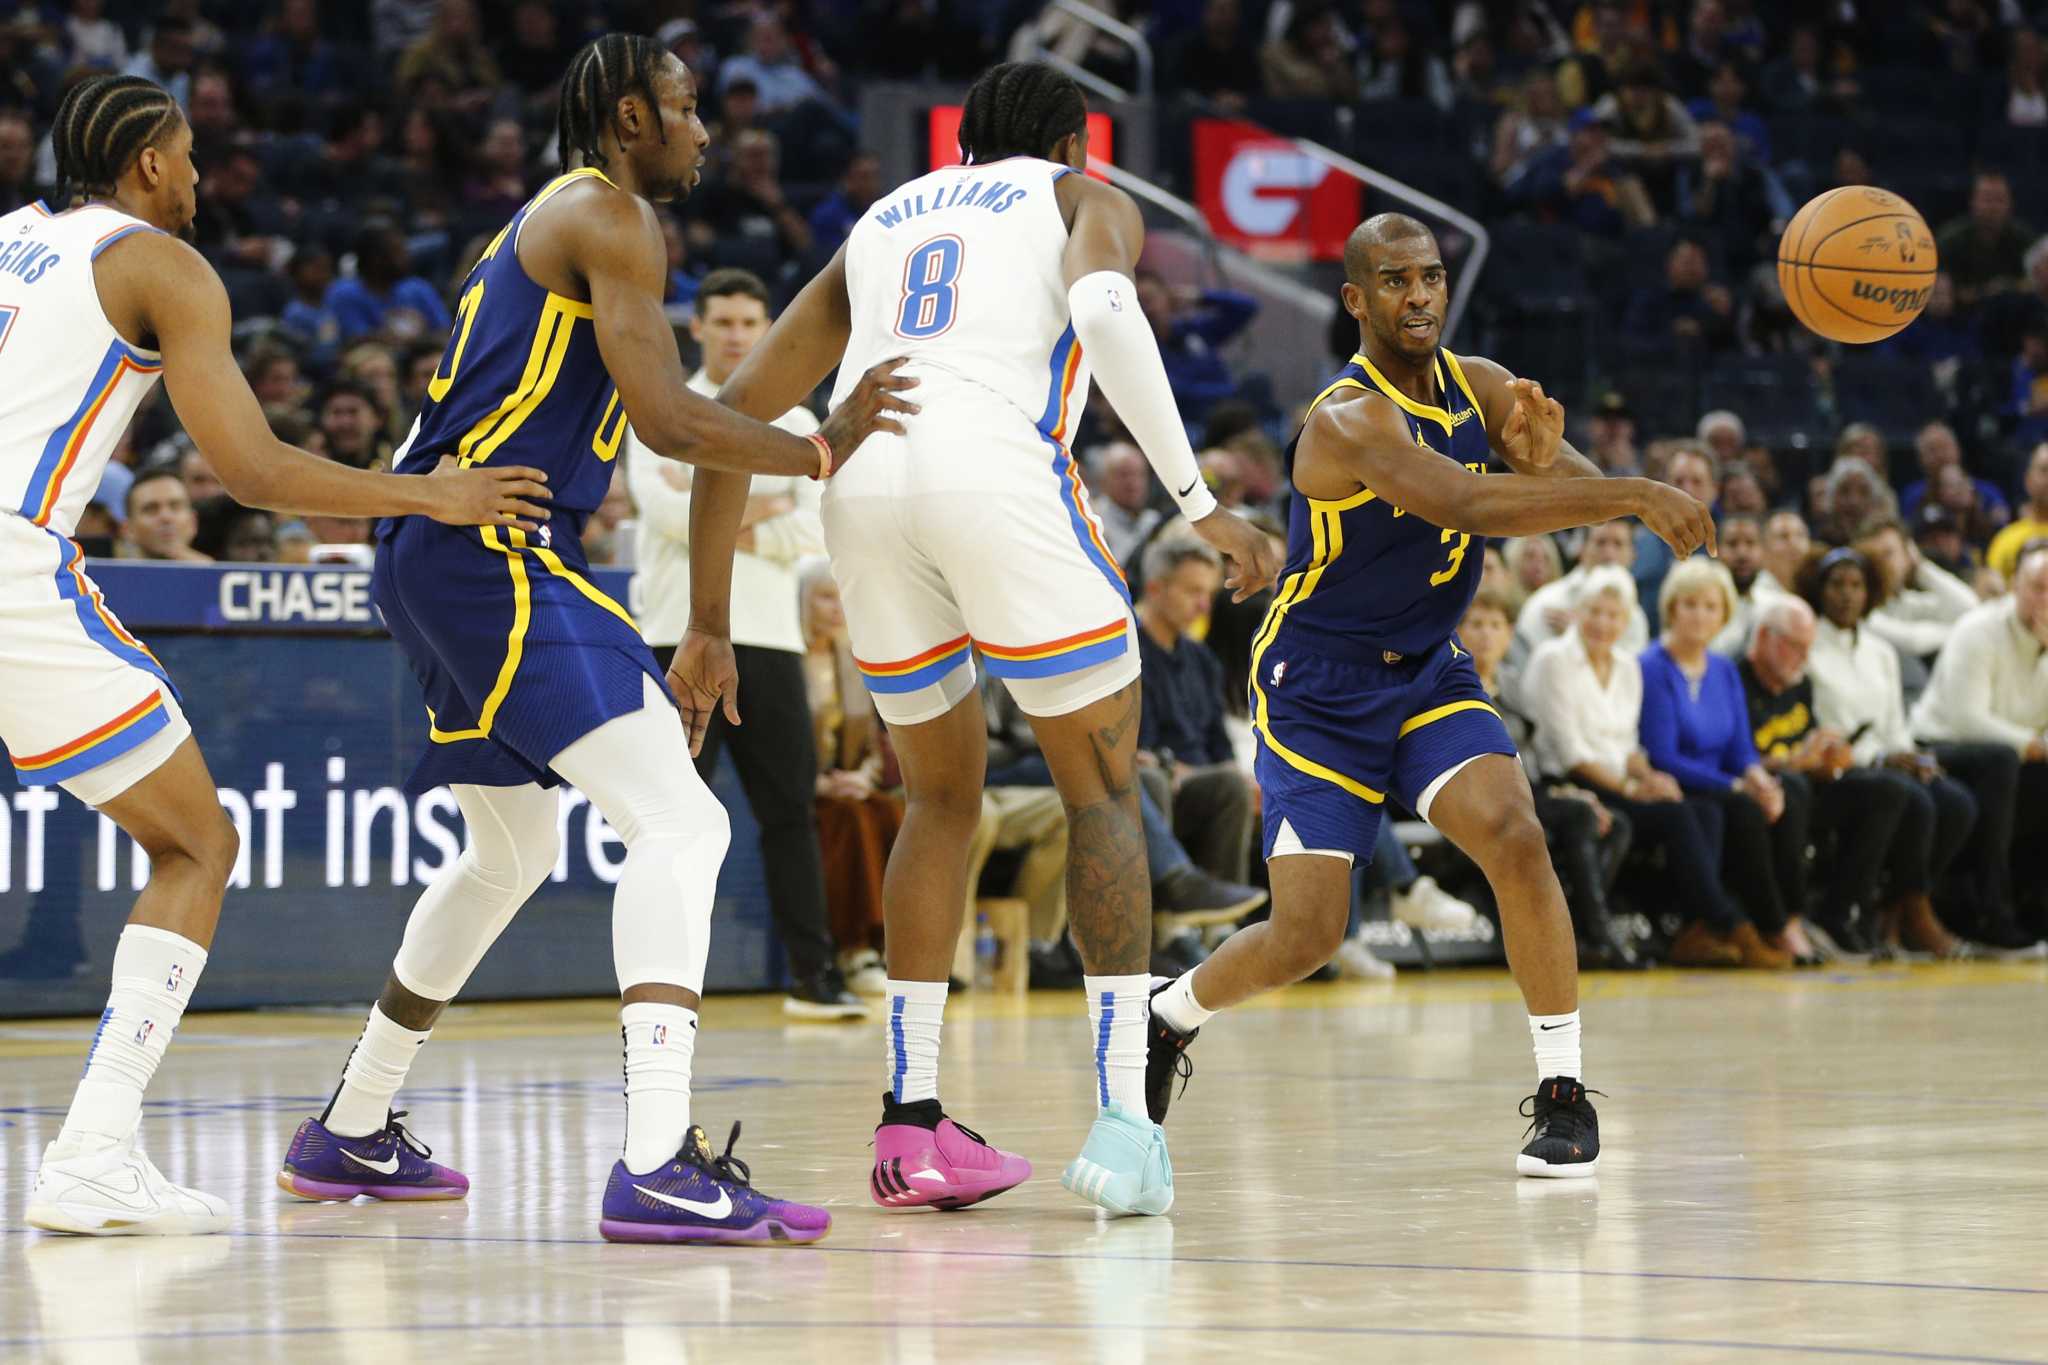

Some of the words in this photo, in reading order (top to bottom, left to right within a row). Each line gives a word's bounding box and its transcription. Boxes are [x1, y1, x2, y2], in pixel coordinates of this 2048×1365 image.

[875, 181, 1028, 229] WILLIAMS
[0, 240, 61, 284] GINS
[893, 233, 965, 341] 8
[1428, 527, 1472, 587] 3
[219, 571, 372, 622] CHASE
